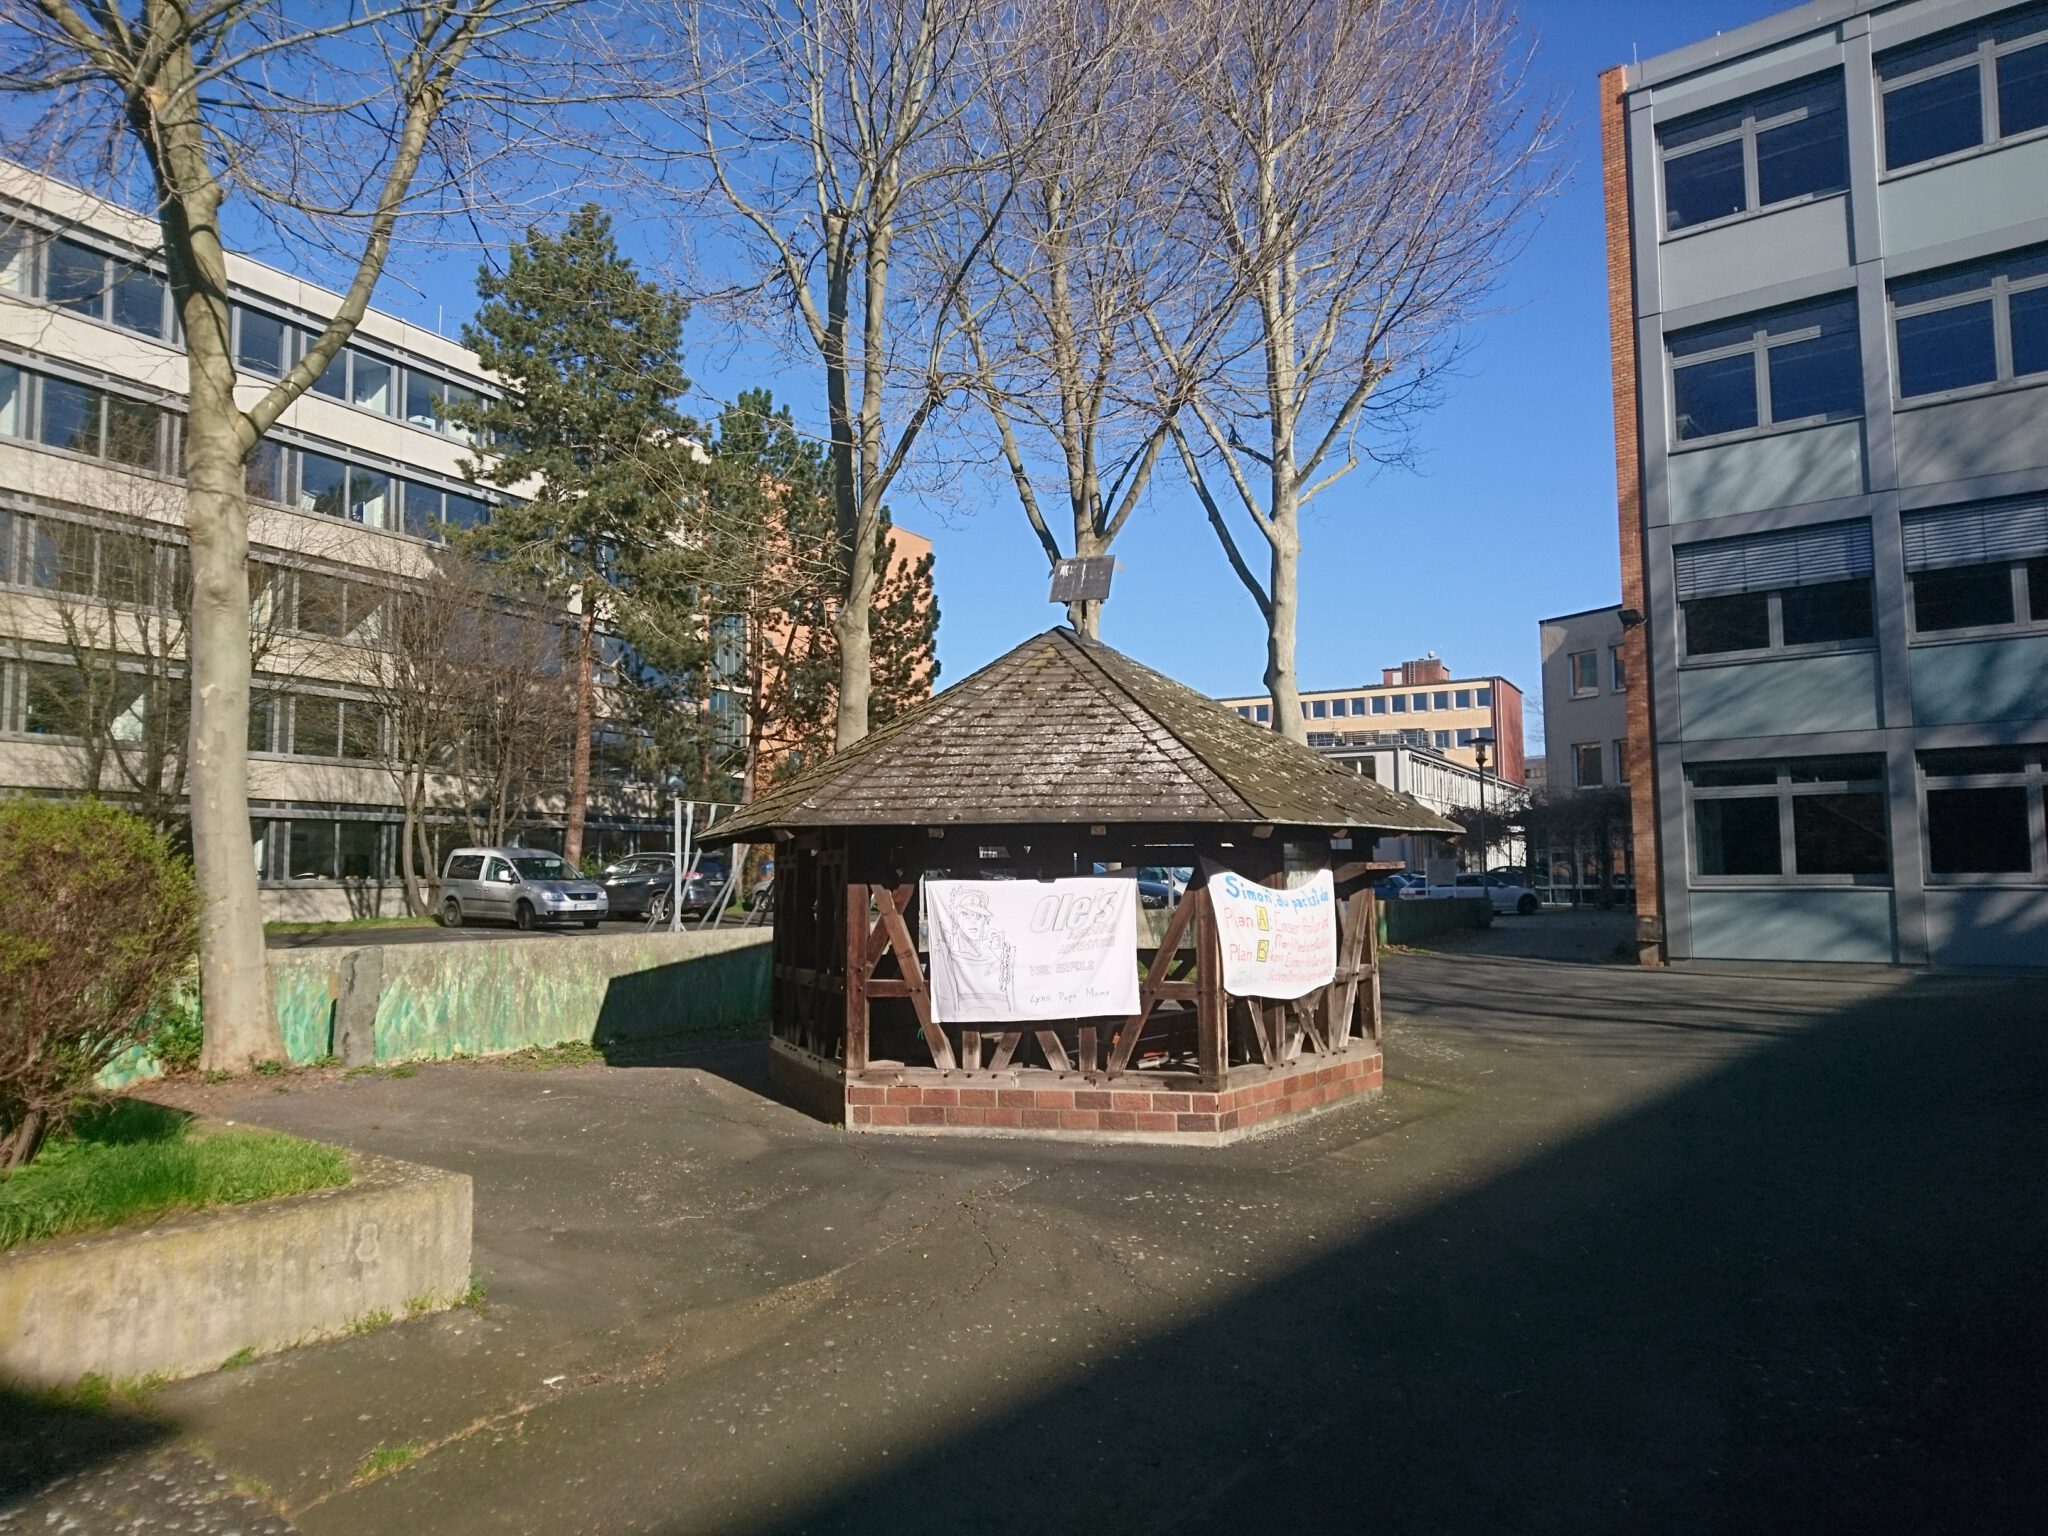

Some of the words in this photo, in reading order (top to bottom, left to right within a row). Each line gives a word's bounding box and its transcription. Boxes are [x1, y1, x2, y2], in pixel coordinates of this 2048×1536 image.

[1223, 906, 1254, 928] Plan
[1229, 943, 1254, 961] Plan
[1030, 994, 1052, 1007] Lynn
